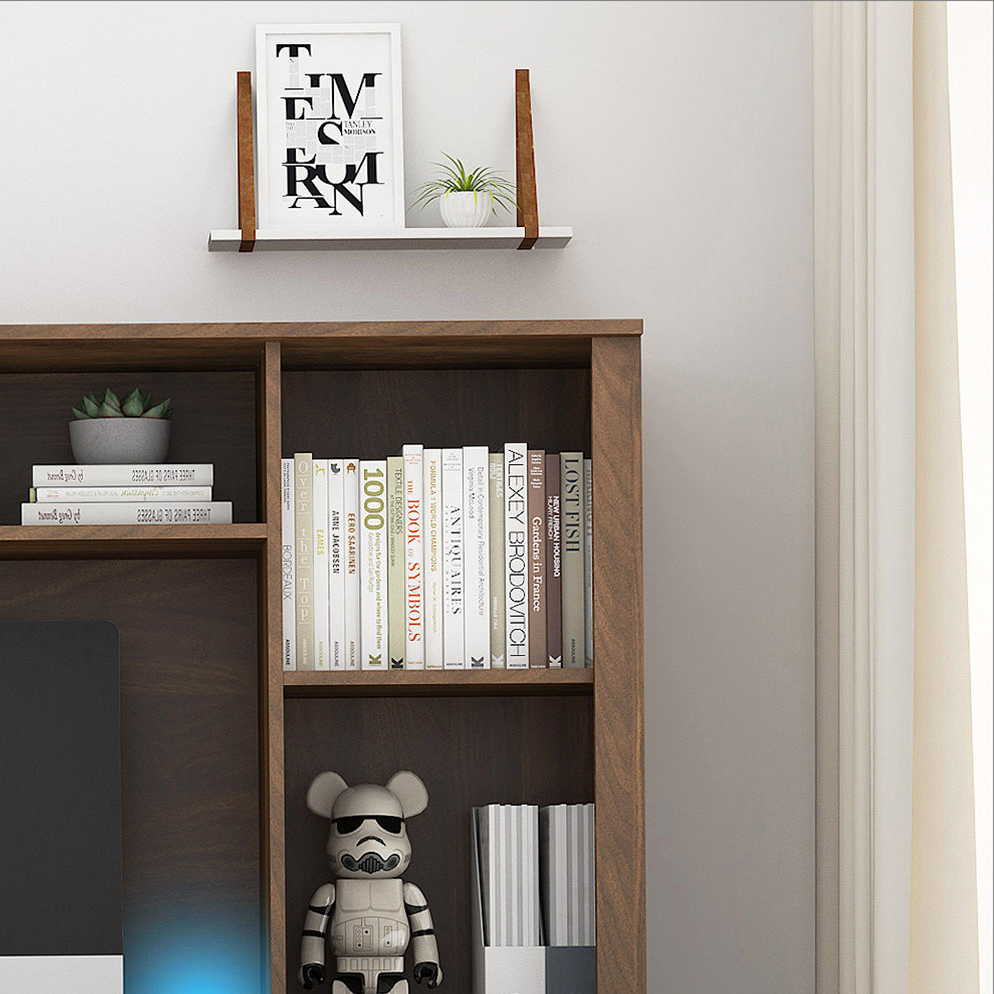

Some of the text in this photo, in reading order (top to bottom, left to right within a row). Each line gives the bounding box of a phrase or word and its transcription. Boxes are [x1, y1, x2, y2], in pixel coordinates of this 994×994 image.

[363, 467, 385, 531] 1000
[395, 468, 403, 535] TEXTILE DESIGNERS
[429, 460, 437, 495] FORMULA
[477, 466, 485, 485] Detail
[508, 449, 525, 525] ALEXEY
[564, 459, 580, 552] LOST FISH
[298, 461, 310, 621] Over the Top
[316, 529, 325, 556] EAMES
[332, 510, 340, 574] ARNE JACOBSEN
[347, 512, 356, 574] EERO SAARINEN
[407, 499, 421, 545] BOOK
[476, 493, 485, 540] Contemporary
[553, 515, 561, 542] URBAN
[282, 544, 293, 600] BORDEAUX
[430, 530, 438, 572] CHAMPIONS
[449, 505, 462, 615] ANTIQUAIRES
[532, 516, 543, 612] Gardens in France
[553, 542, 561, 577] HOUSING
[408, 562, 422, 642] SYMBOLS
[478, 577, 486, 616] Architecture
[508, 531, 526, 657] BRODOVITCH
